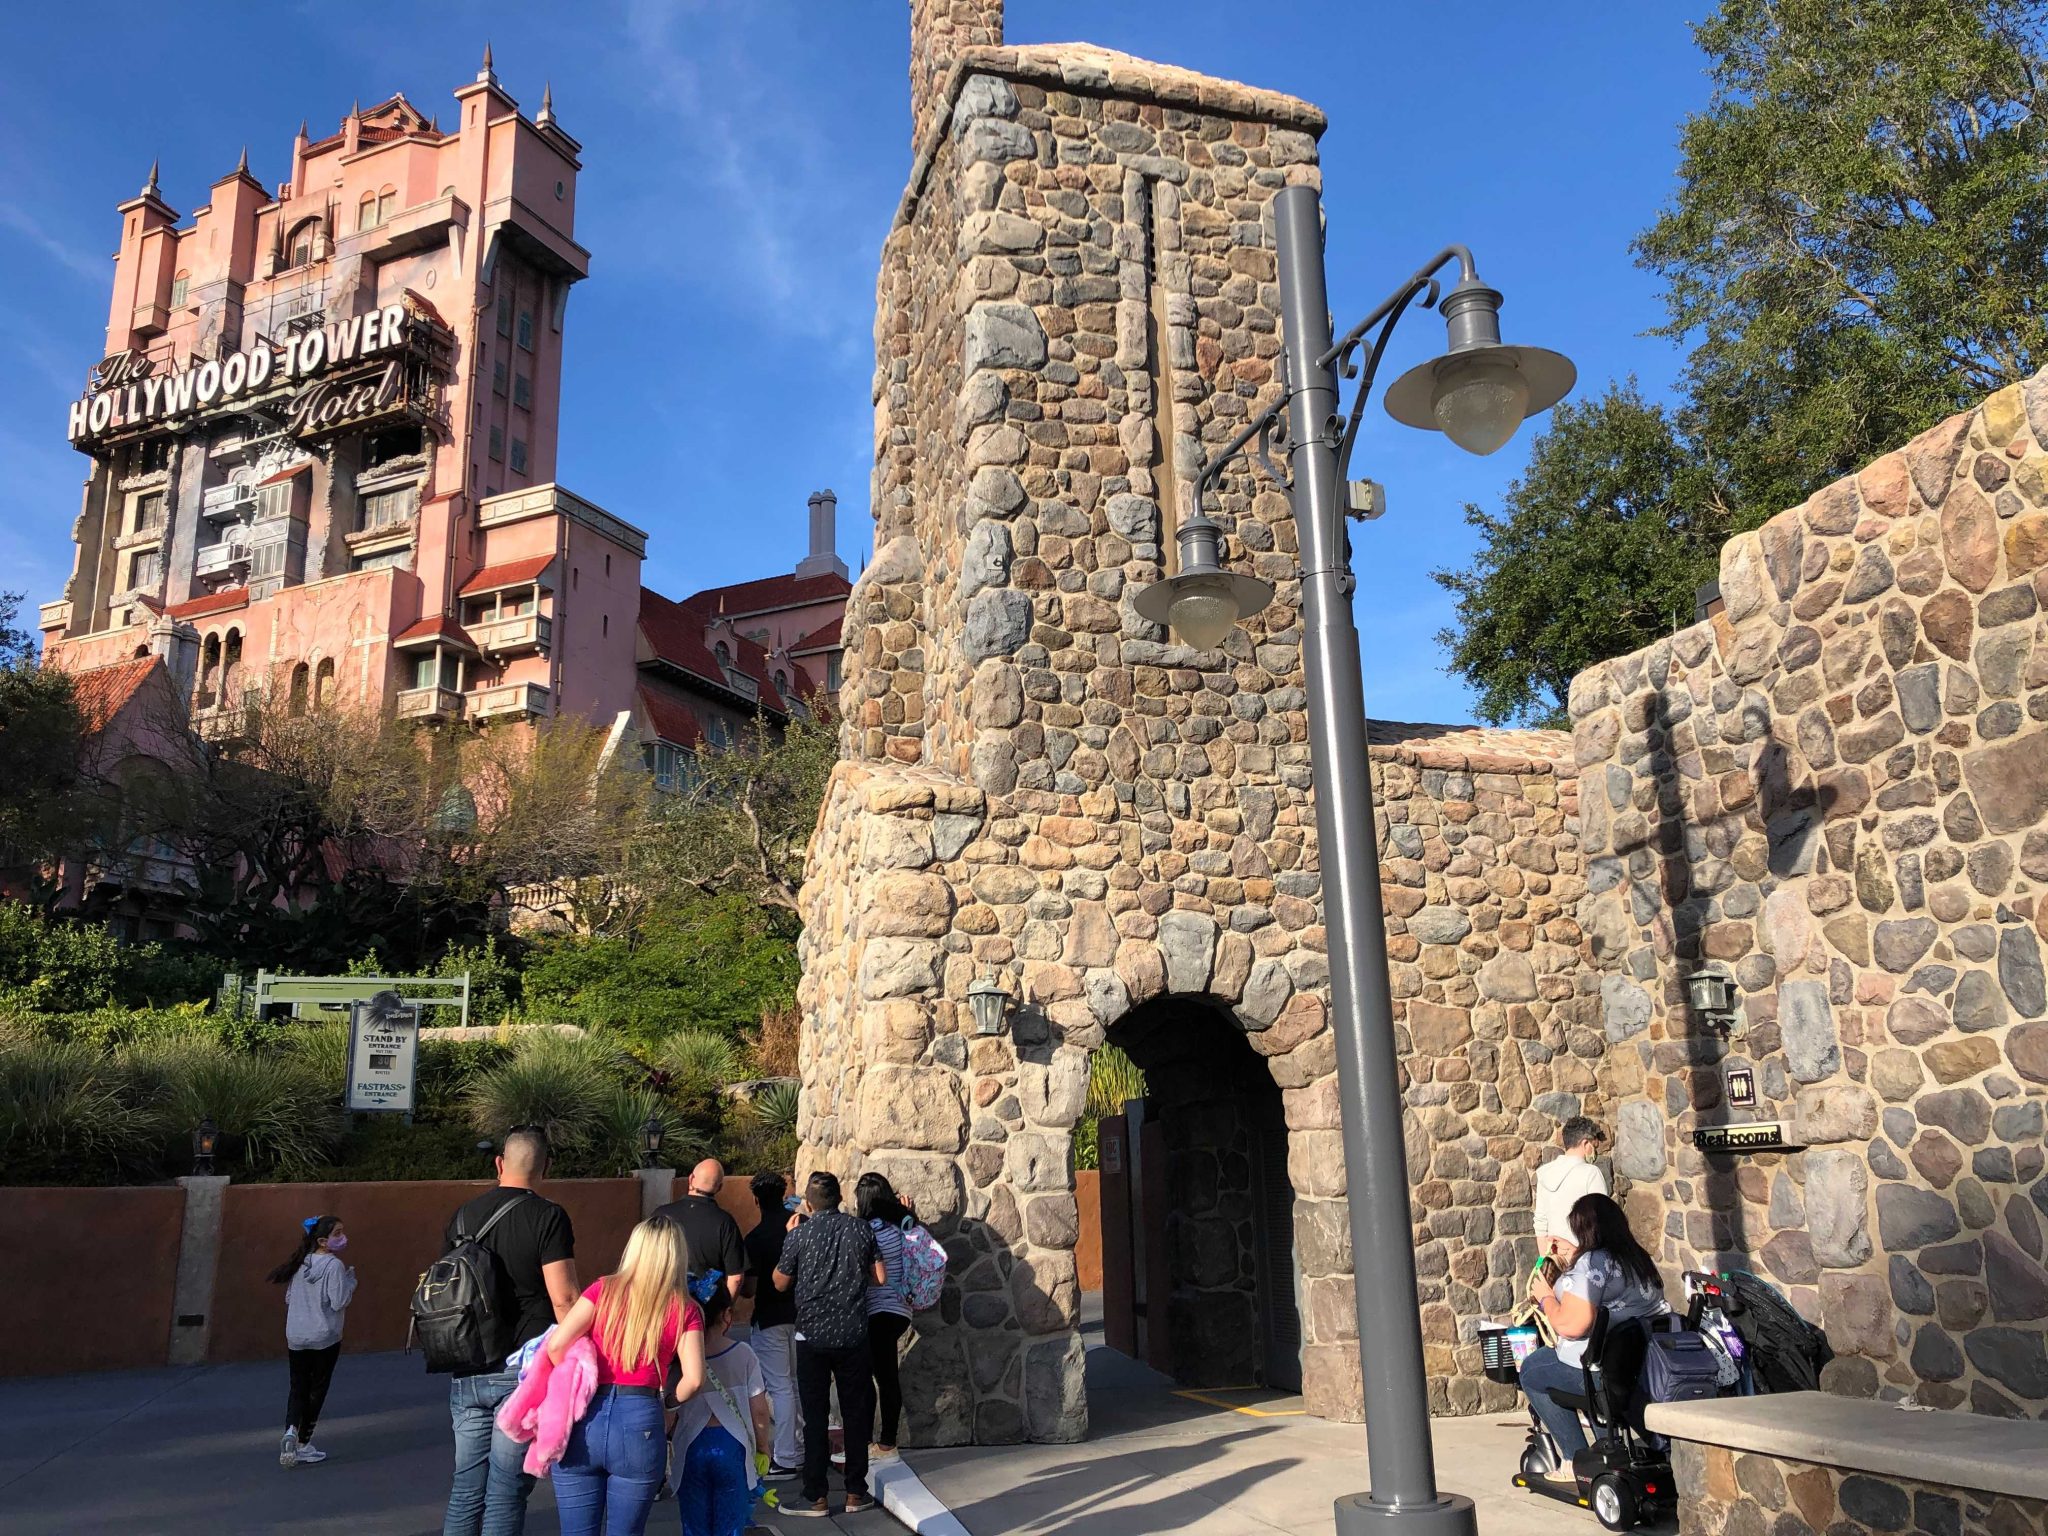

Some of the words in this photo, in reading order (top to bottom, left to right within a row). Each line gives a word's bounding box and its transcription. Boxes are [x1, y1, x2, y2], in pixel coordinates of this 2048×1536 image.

[68, 346, 272, 441] HOLLYWOOD
[283, 304, 407, 377] TOWER
[97, 347, 151, 390] The
[286, 361, 400, 435] Hotel
[357, 1083, 406, 1091] FASTPASS+
[1694, 1130, 1778, 1145] Restrooms
